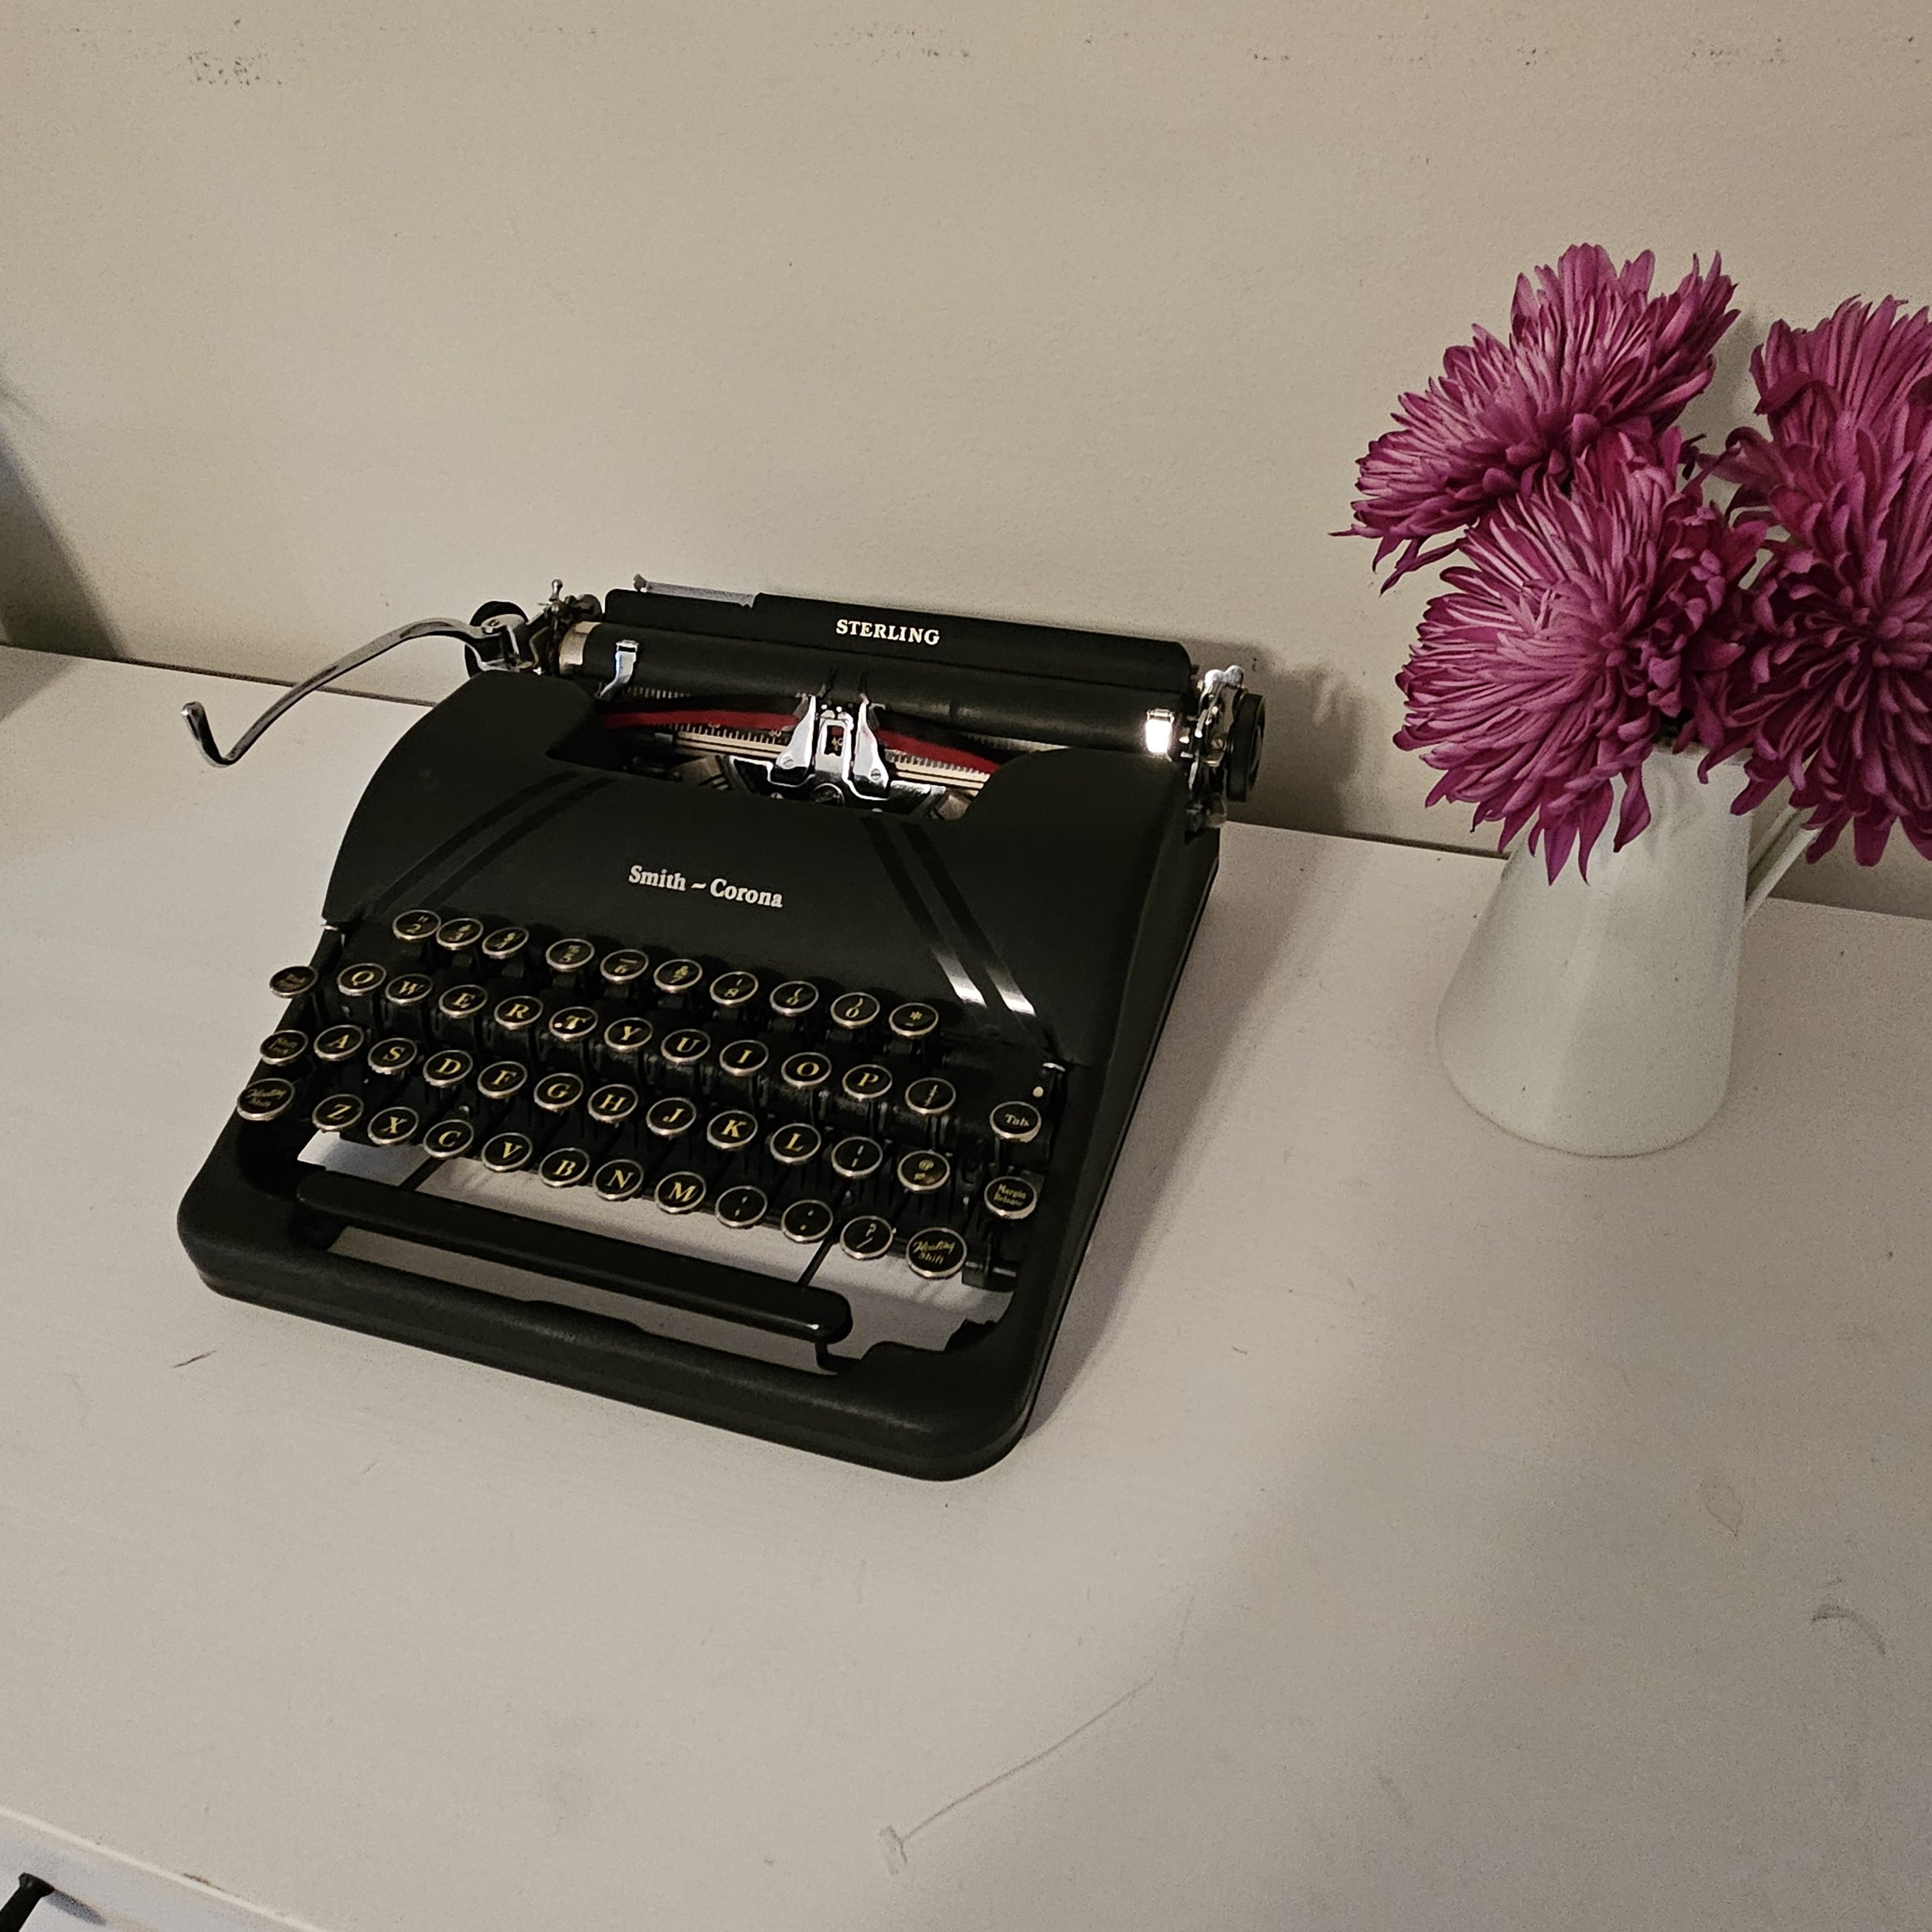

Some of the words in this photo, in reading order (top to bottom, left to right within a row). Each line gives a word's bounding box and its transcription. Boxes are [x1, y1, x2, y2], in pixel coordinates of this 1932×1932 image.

[835, 619, 940, 645] STERLING
[628, 865, 686, 891] Smith
[709, 878, 783, 908] Corona
[350, 970, 375, 986] Q
[398, 981, 424, 995] W
[452, 992, 476, 1009] E
[505, 1003, 530, 1019] R
[565, 1015, 587, 1030] T
[328, 1034, 349, 1049] A
[621, 1026, 641, 1041] Y
[676, 1037, 700, 1053] U
[383, 1046, 405, 1061] S
[737, 1049, 753, 1064] I
[436, 1058, 461, 1075] D
[796, 1061, 820, 1077] O
[492, 1070, 517, 1086] F
[858, 1073, 879, 1087] P
[546, 1083, 571, 1098] G
[598, 1094, 626, 1111] H
[326, 1104, 352, 1121] Z
[662, 1108, 685, 1123] J
[1005, 1113, 1029, 1127] Tab
[382, 1116, 407, 1134] X
[721, 1120, 747, 1138] K
[437, 1130, 462, 1148] C
[784, 1133, 804, 1151] L
[502, 1141, 523, 1158] V
[553, 1159, 577, 1176] B
[607, 1169, 634, 1189] N
[668, 1182, 697, 1202] M
